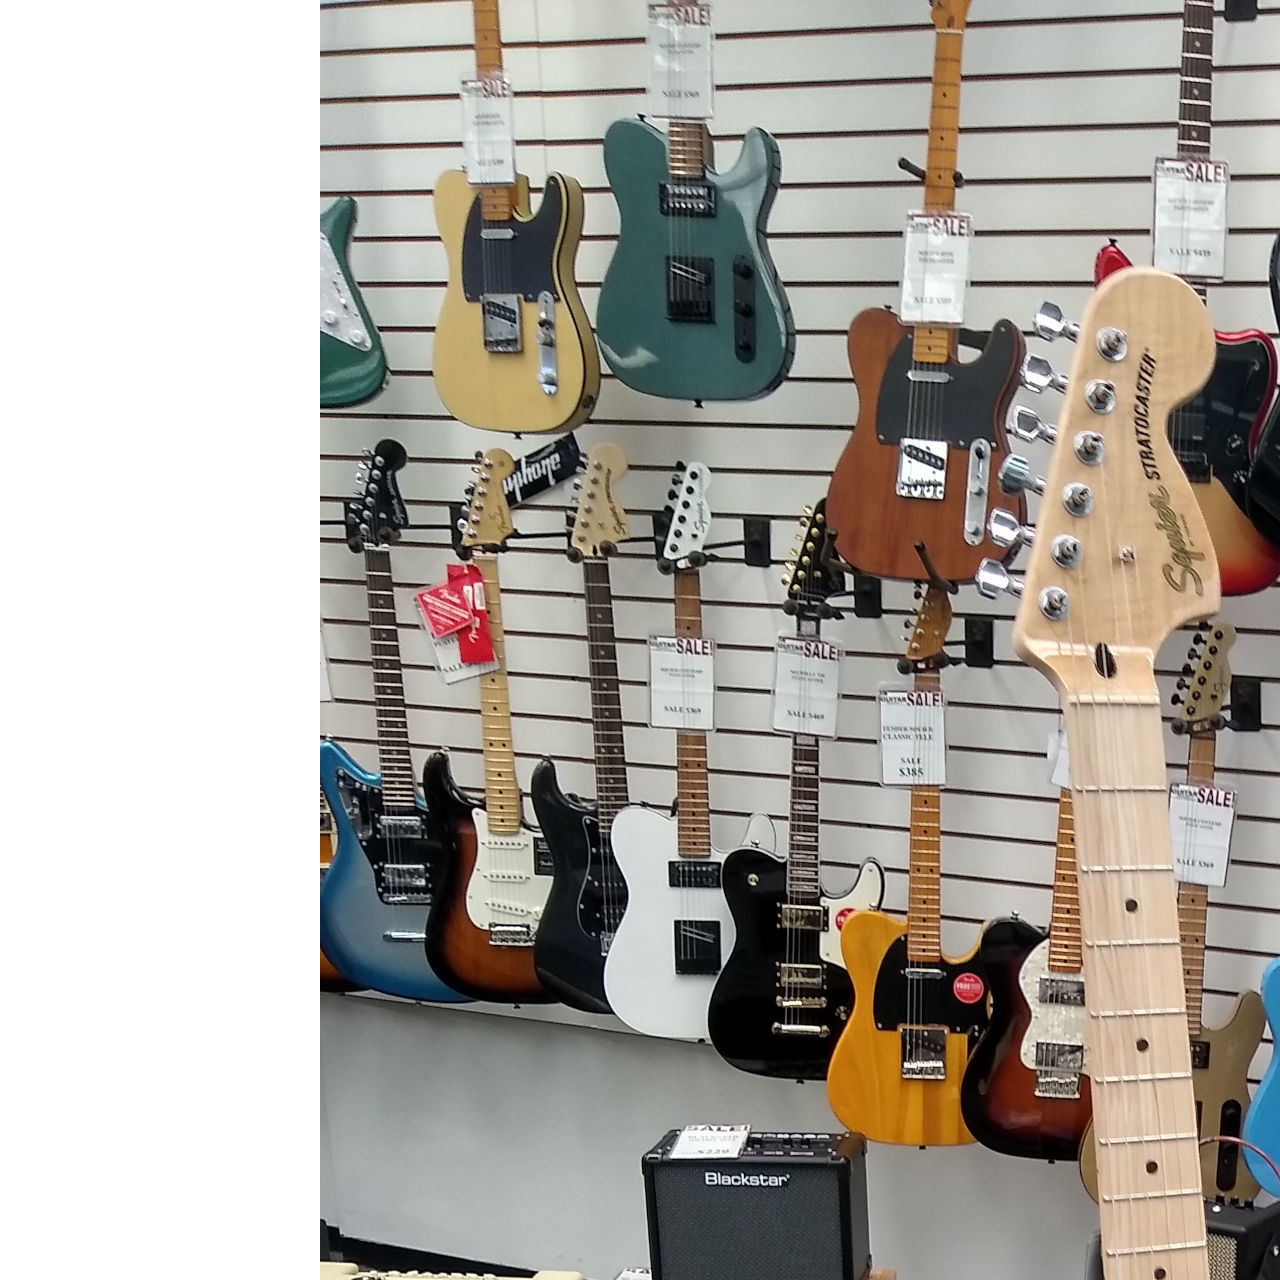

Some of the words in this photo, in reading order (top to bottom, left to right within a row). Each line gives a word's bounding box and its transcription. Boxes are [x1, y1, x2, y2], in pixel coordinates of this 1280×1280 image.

[1185, 161, 1228, 184] SALE!
[1134, 352, 1161, 482] STRATOCASTER
[1147, 484, 1207, 597] Squier
[676, 638, 713, 656] SALE!
[804, 642, 840, 662] SALE!
[906, 691, 945, 708] SALE!
[883, 733, 912, 741] CLASSIC
[900, 757, 921, 765] SALE
[899, 766, 924, 778] $385
[1197, 786, 1236, 808] SALE!
[704, 1171, 788, 1187] Blackstar
